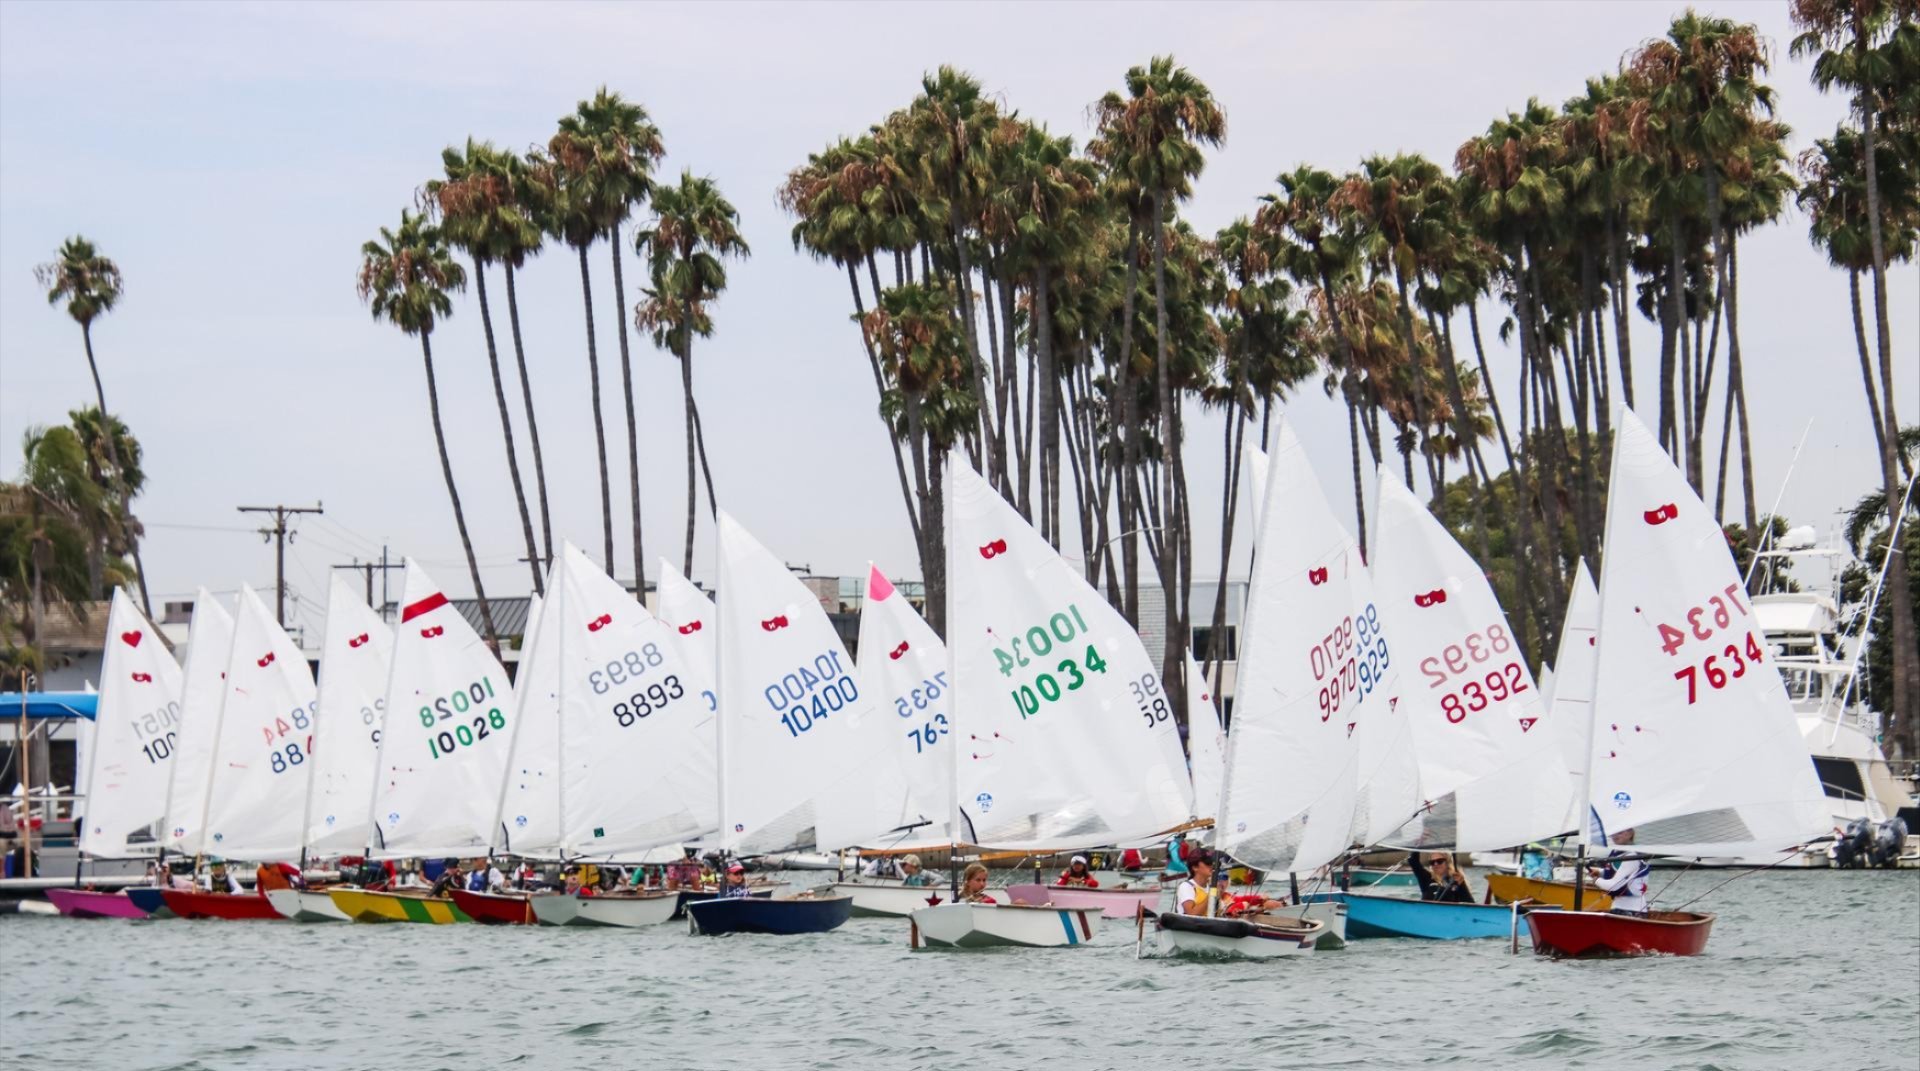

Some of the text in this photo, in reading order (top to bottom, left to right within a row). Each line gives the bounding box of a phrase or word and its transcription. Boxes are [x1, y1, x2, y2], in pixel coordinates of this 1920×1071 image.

[1011, 644, 1107, 720] 10034
[1319, 657, 1356, 722] 9970
[1358, 637, 1389, 704] 929
[1440, 662, 1528, 724] 8392
[1674, 631, 1763, 705] 7634
[613, 675, 685, 728] 8893
[781, 676, 859, 738] 10400
[428, 708, 506, 760] 10028
